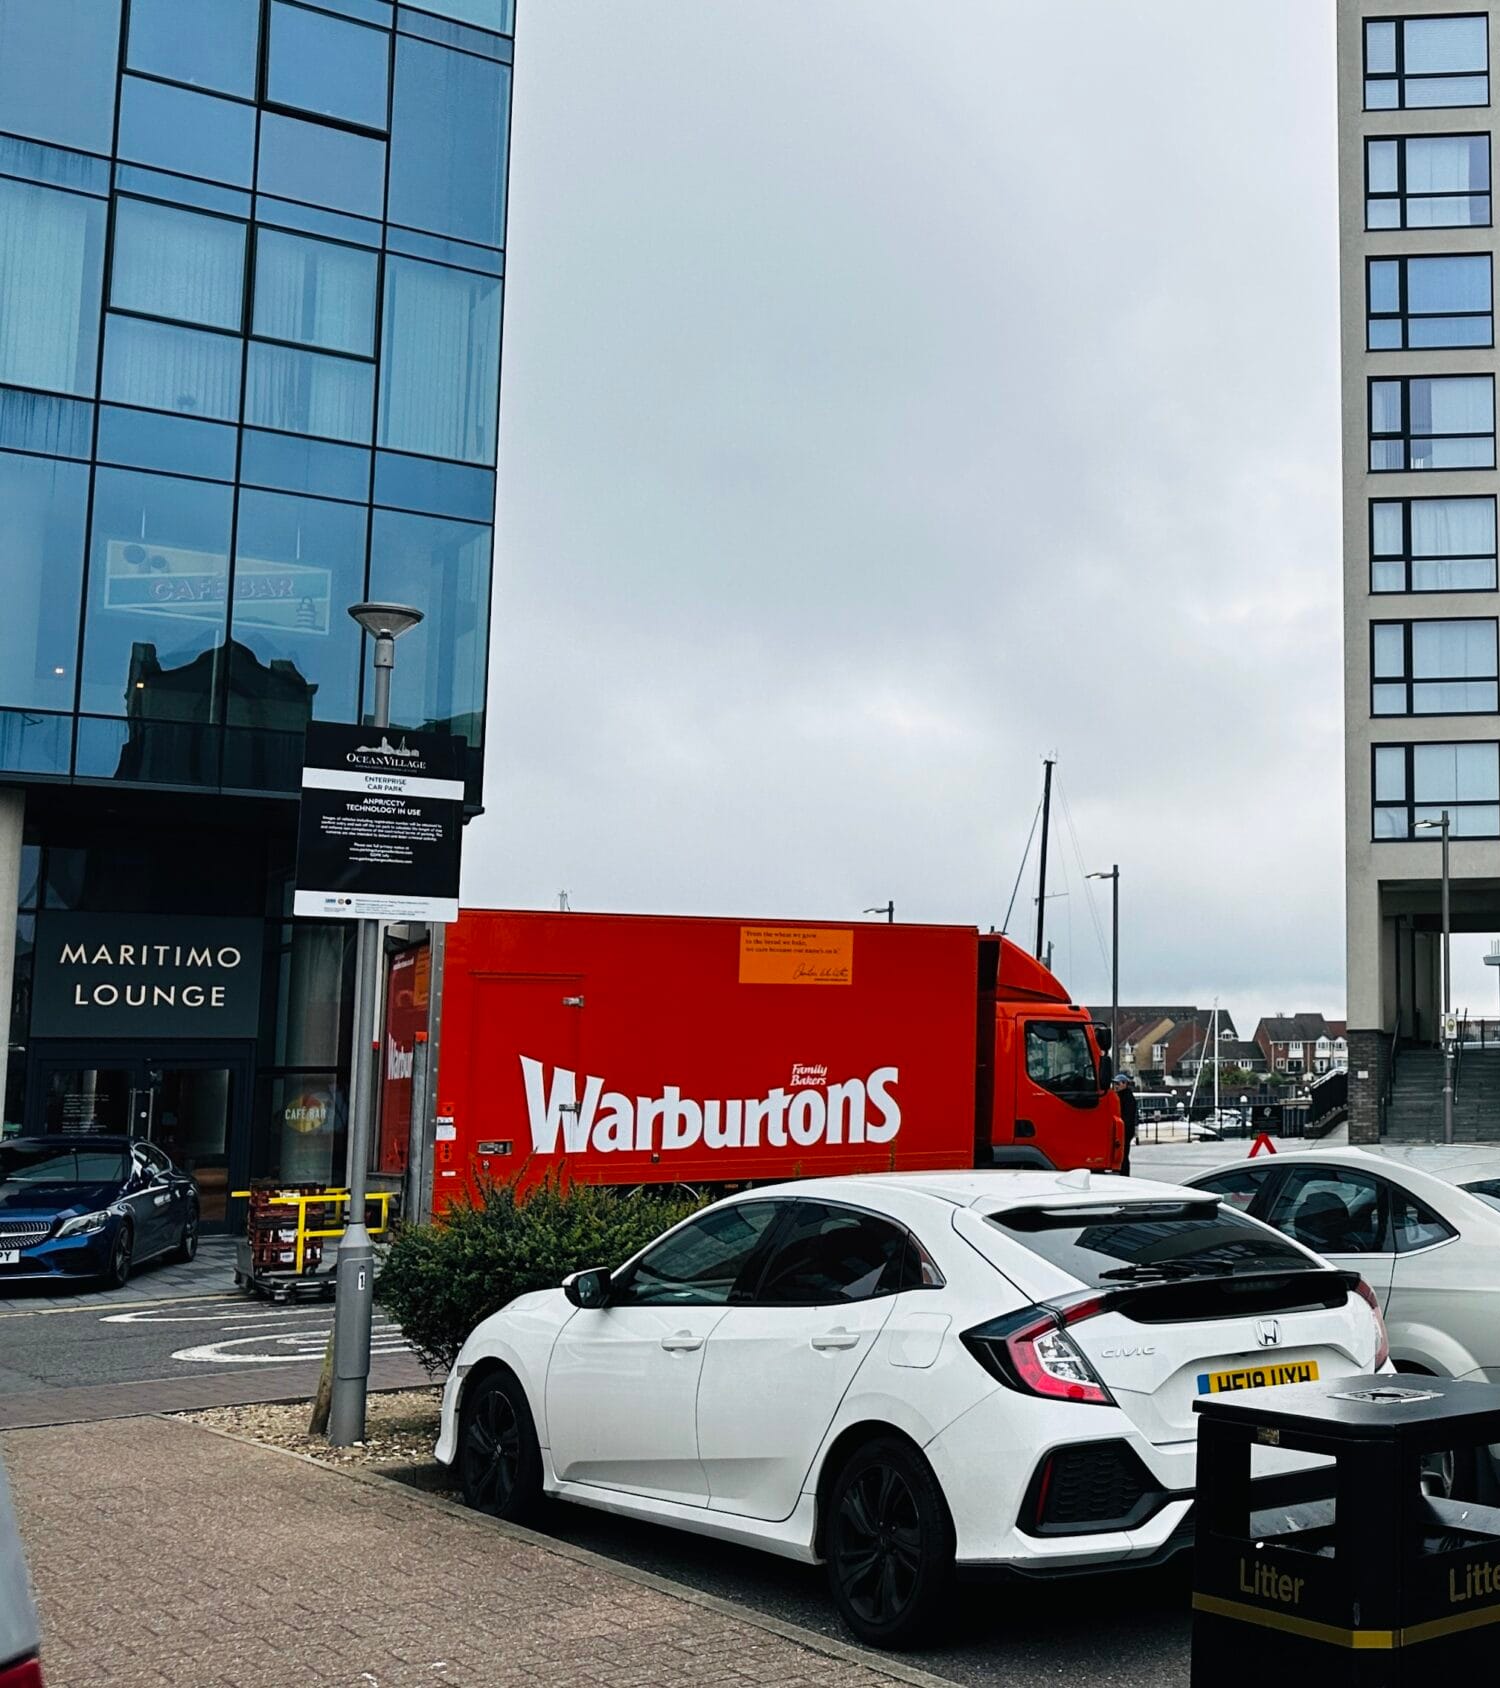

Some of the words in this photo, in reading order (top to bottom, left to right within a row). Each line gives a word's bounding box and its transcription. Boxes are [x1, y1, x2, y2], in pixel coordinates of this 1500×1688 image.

[365, 776, 406, 785] ENTERPRISE
[346, 804, 396, 813] TECHNOLOGY
[60, 943, 241, 968] MARITIMO
[75, 984, 225, 1007] LOUNGE
[792, 1064, 827, 1076] Family
[790, 1075, 827, 1086] Bakers
[519, 1055, 900, 1153] Warburtons
[1101, 1347, 1156, 1358] CIVIC
[1240, 1558, 1304, 1604] Litter
